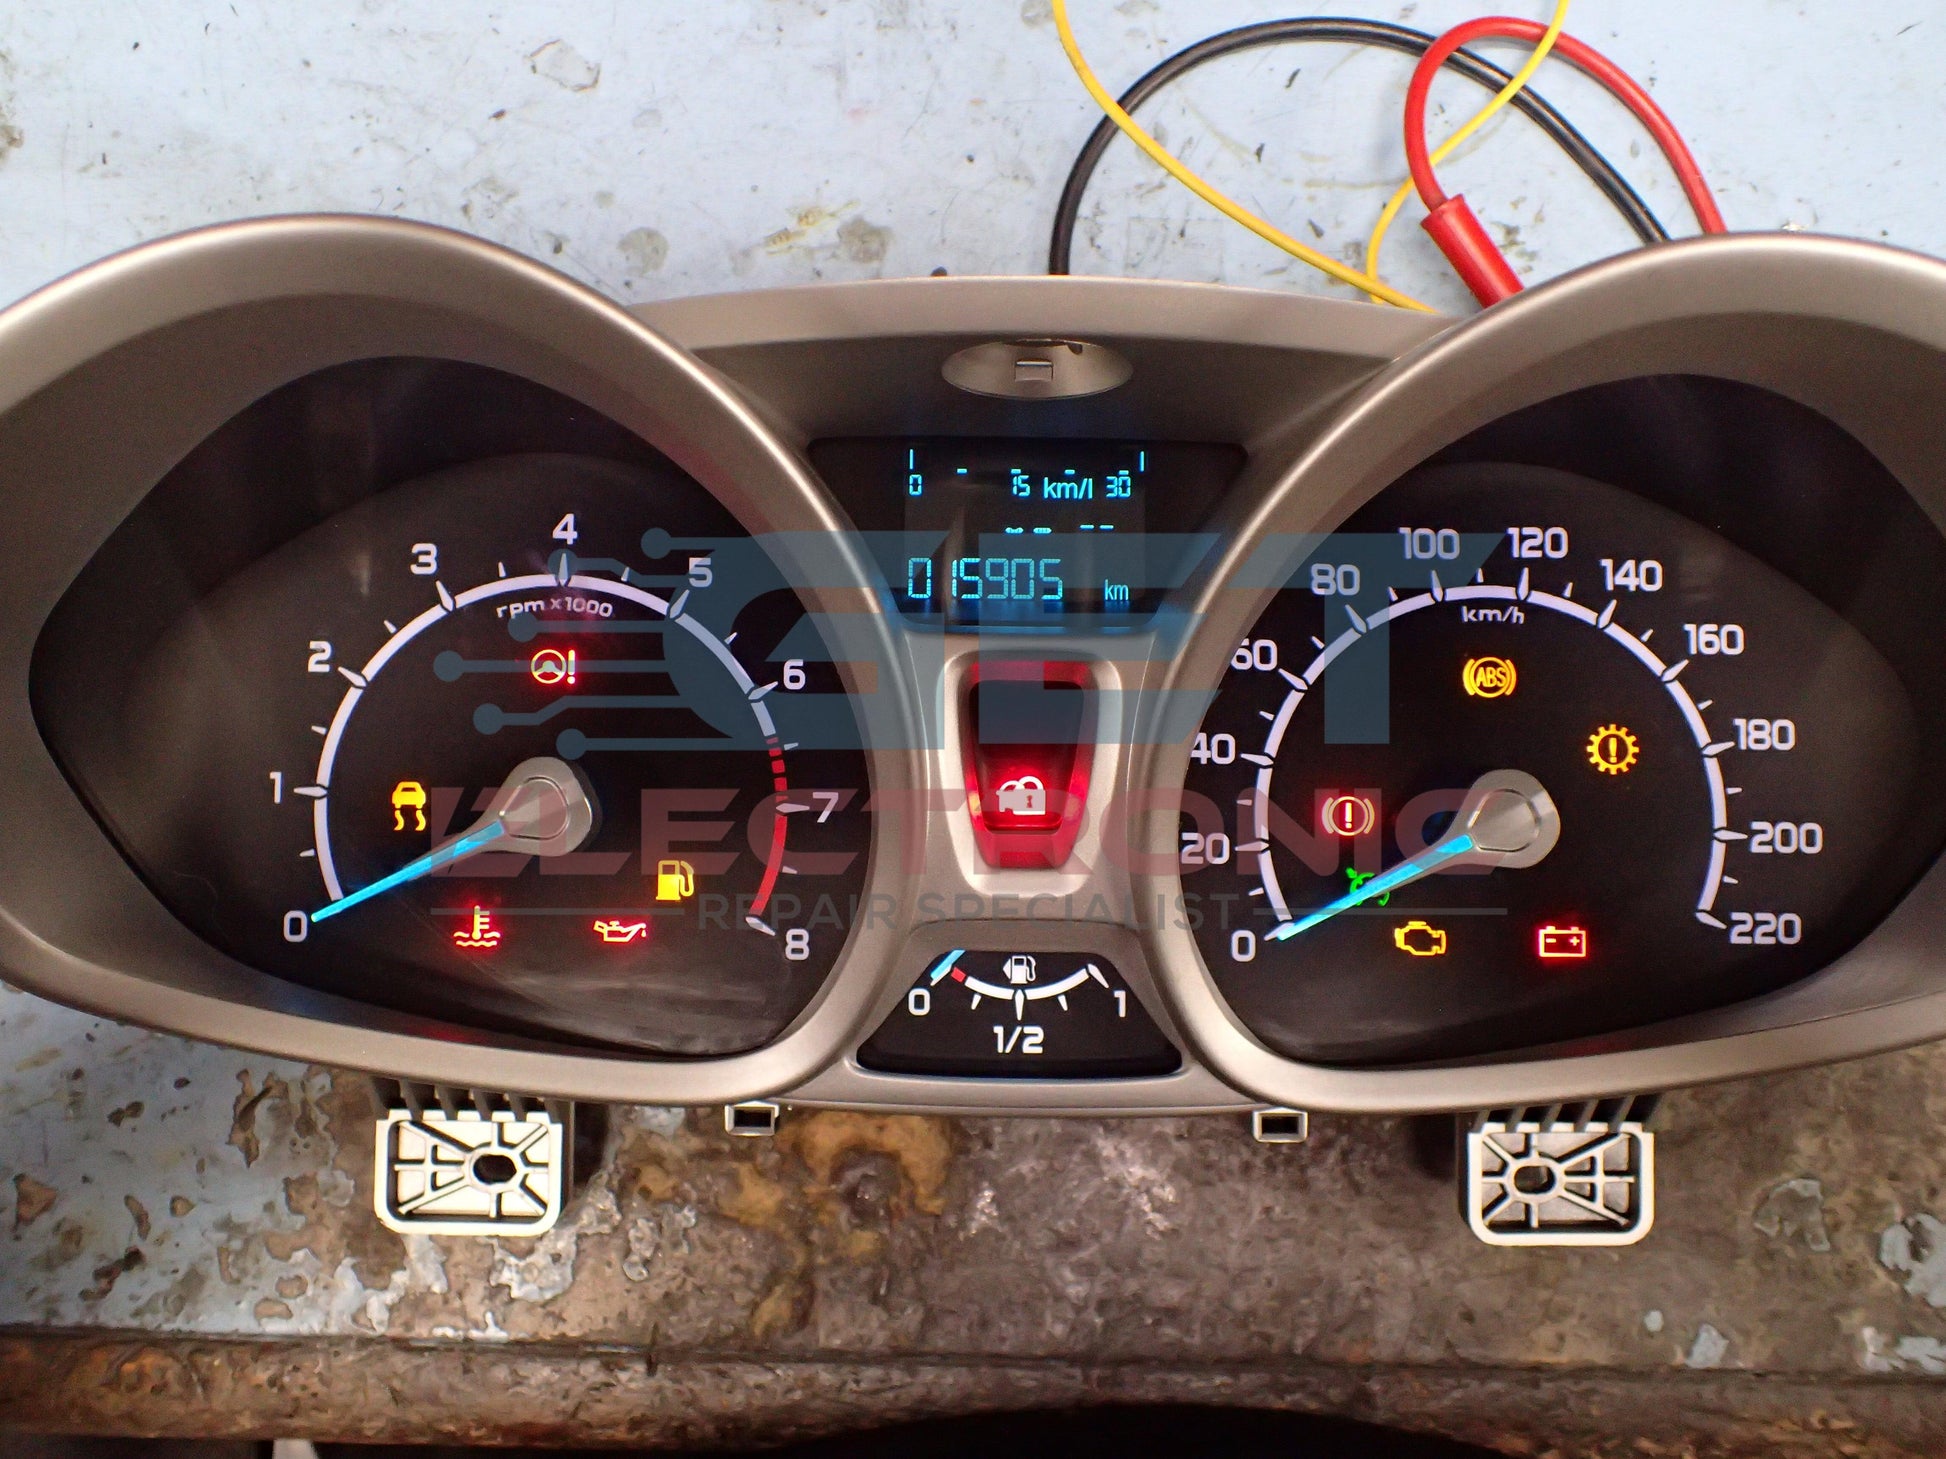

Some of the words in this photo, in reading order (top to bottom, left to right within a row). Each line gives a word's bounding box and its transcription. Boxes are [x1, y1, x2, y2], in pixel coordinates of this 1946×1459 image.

[908, 474, 923, 496] 0
[1012, 475, 1031, 497] 15
[1043, 477, 1093, 499] km/l
[1105, 475, 1132, 498] 30
[552, 514, 578, 545] 4
[1398, 527, 1460, 560] 100
[1506, 527, 1568, 559] 120
[410, 543, 437, 575] 3
[688, 557, 713, 588] 5
[1104, 579, 1129, 601] km
[1310, 563, 1360, 597] 80
[1600, 559, 1663, 593] 140
[496, 600, 545, 619] rpm
[1461, 605, 1525, 625] km/h
[1230, 638, 1278, 671] 60
[1684, 624, 1745, 657] 160
[307, 641, 333, 673] 2
[783, 659, 807, 690] 6
[1475, 666, 1507, 688] ABS
[1189, 733, 1236, 765] 40
[1735, 719, 1796, 752] 180
[269, 771, 282, 803] 1
[812, 792, 839, 824] 7
[1181, 833, 1230, 865] 20
[1750, 822, 1823, 854] 200
[284, 911, 308, 942] 0
[1729, 912, 1802, 945] 220
[785, 929, 810, 961] 8
[1231, 929, 1256, 962] 0
[908, 987, 931, 1017] 0
[1113, 990, 1127, 1018] 1
[993, 1025, 1045, 1055] 1/2
